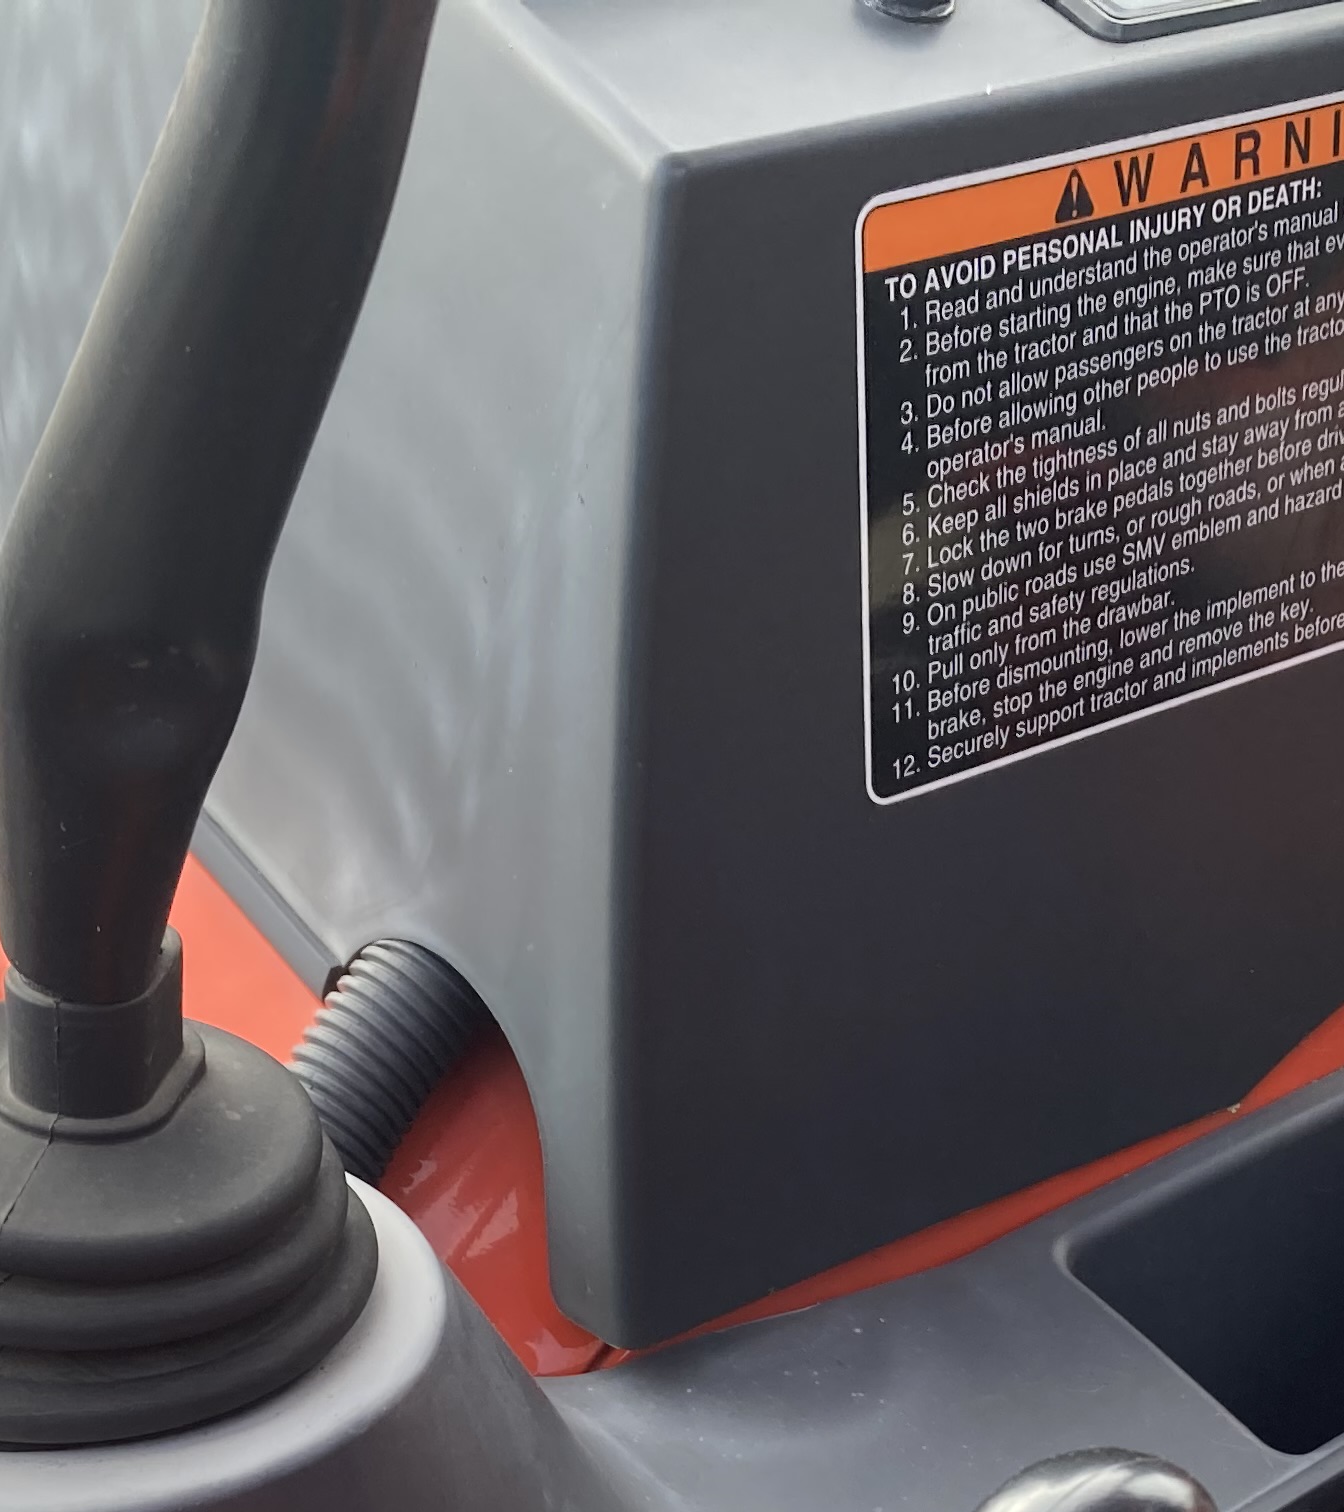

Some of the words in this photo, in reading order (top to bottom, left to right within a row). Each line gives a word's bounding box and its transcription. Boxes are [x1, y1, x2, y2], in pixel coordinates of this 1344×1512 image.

[884, 273, 917, 302] TO
[924, 254, 996, 294] AVOID
[1003, 224, 1123, 275] PERSONAL
[1129, 202, 1206, 244] INJURY
[1211, 195, 1242, 223] OR
[1248, 176, 1322, 215] DEATH:
[900, 401, 919, 425] 3.
[926, 393, 955, 419] Do
[961, 380, 993, 409] not
[998, 369, 1049, 399] allow
[1054, 339, 1164, 389] passengers
[1169, 331, 1192, 353] on
[1198, 320, 1226, 345] the
[1232, 304, 1289, 336] tractor
[1293, 295, 1310, 320] at
[925, 359, 970, 388] from
[977, 348, 1008, 374] the
[1014, 331, 1077, 365] tractor
[1082, 315, 1118, 347] and
[1124, 306, 1159, 336] that
[1164, 300, 1193, 325] the
[1199, 284, 1241, 316] PTO
[1246, 280, 1260, 304] is
[1266, 266, 1309, 298] OFF.
[902, 492, 920, 516] 5.
[927, 471, 990, 509] Check
[996, 464, 1027, 489] the
[1032, 438, 1118, 481] tightness
[1123, 426, 1141, 453] of
[1146, 419, 1167, 446] all
[1173, 410, 1211, 439] nuts
[1216, 395, 1250, 426] and
[1255, 386, 1297, 415] bolts
[927, 433, 1025, 482] operator's
[1031, 408, 1106, 450] manual.
[892, 669, 920, 695] 10.
[928, 652, 963, 684] Pull
[969, 641, 1009, 670] only
[1014, 628, 1056, 656] from
[1062, 616, 1091, 641] the
[1096, 590, 1175, 630] drawbar.
[928, 621, 982, 656] traffic
[987, 604, 1023, 637] and
[1029, 590, 1086, 623] safety
[1091, 558, 1195, 604] regulations.
[928, 708, 986, 740] brake,
[993, 691, 1033, 719] stop
[1039, 680, 1067, 703] the
[1073, 657, 1134, 691] engine
[1139, 638, 1173, 669] and
[1178, 621, 1243, 656] remove
[1248, 611, 1275, 633] the
[1280, 598, 1314, 622] key.
[892, 754, 921, 780] 12.
[927, 724, 1010, 768] Securely
[1015, 697, 1085, 738] support
[1090, 678, 1149, 713] tractor
[1153, 660, 1186, 692] and
[1191, 631, 1289, 679] implements
